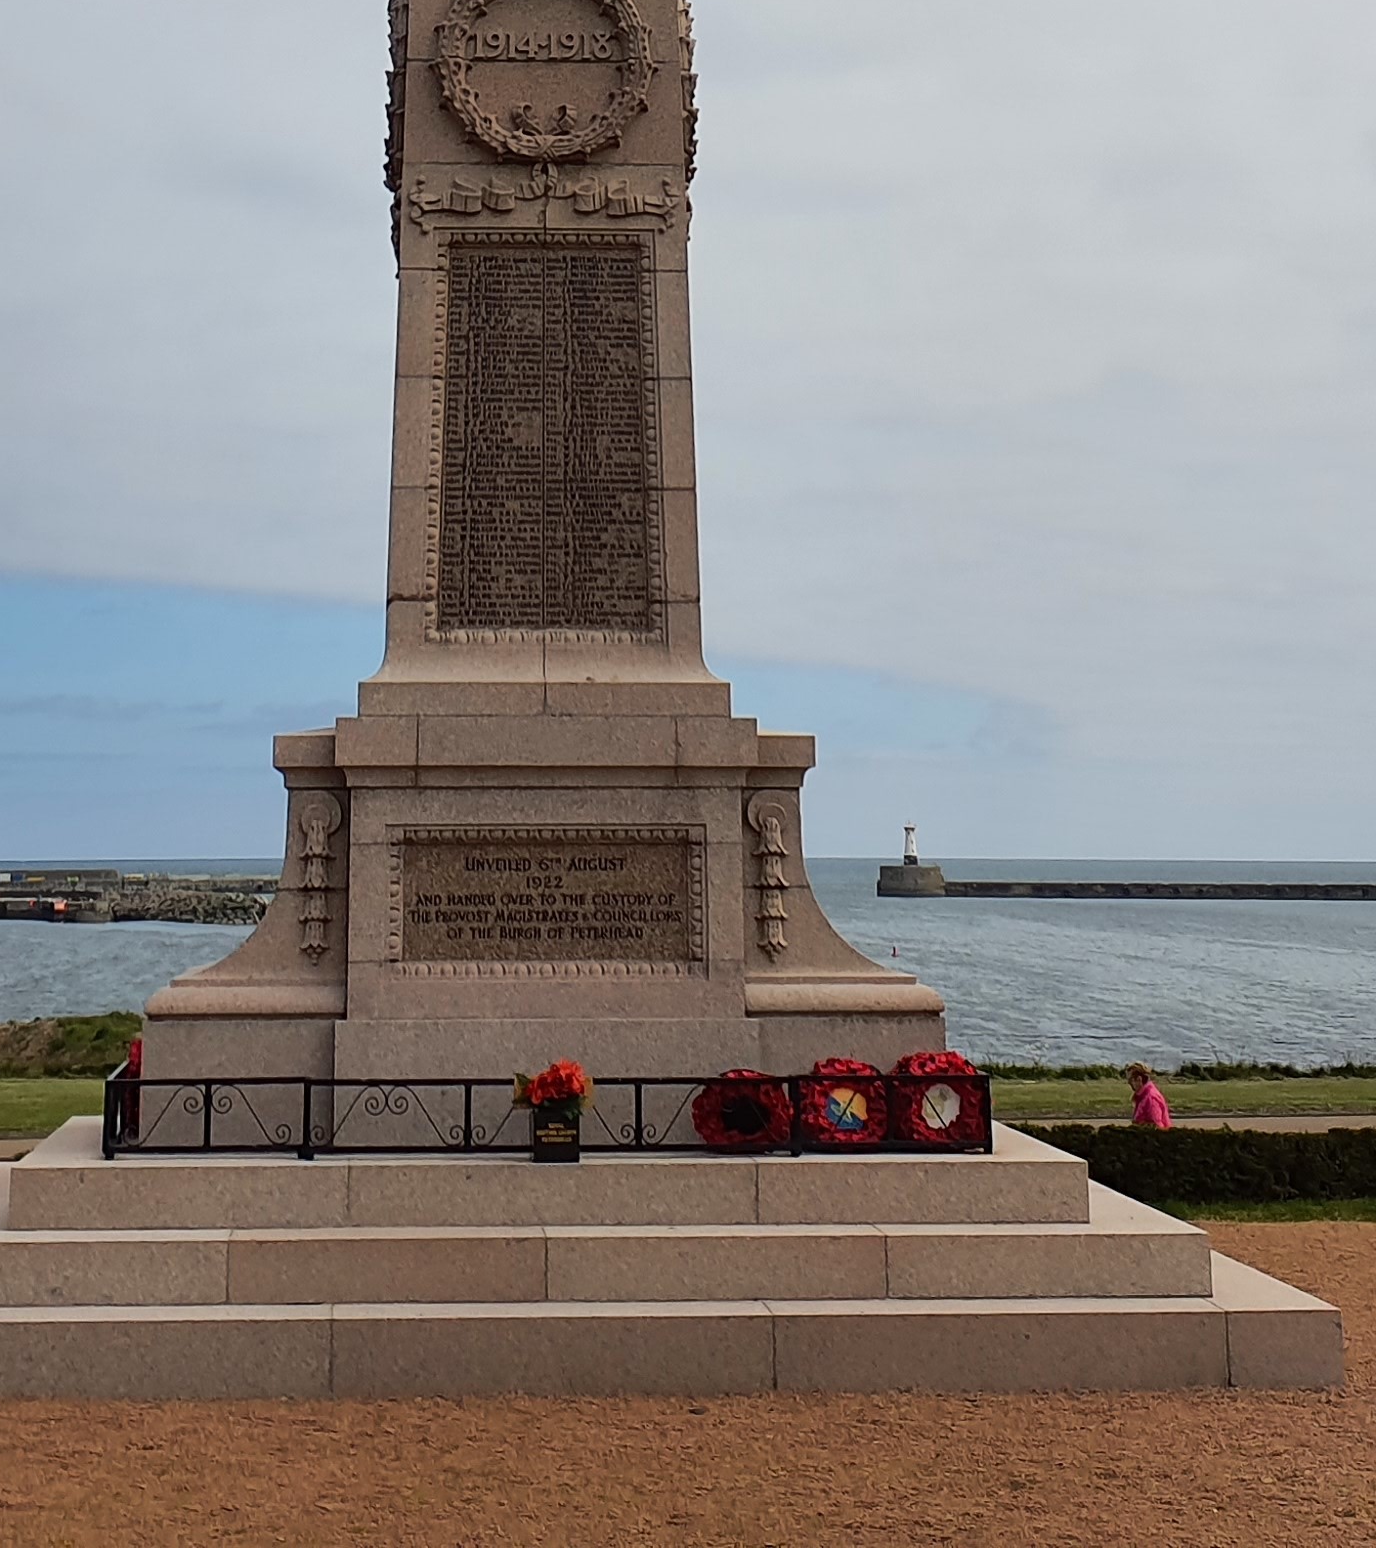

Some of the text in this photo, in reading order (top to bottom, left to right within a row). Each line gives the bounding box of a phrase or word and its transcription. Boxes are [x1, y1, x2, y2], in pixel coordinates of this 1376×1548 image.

[465, 856, 532, 872] UNVEILED
[567, 856, 627, 872] AUGUST
[526, 875, 564, 890] 1922
[415, 893, 676, 907] AND HANDED OVER TO THE CUSTODY OF
[409, 909, 433, 924] THE
[435, 909, 492, 923] PROVOST
[495, 909, 579, 923] MAGISTRATES
[593, 910, 683, 923] COUNCILLORS
[447, 926, 644, 940] OF THE BURGH OF PETERHEAD
